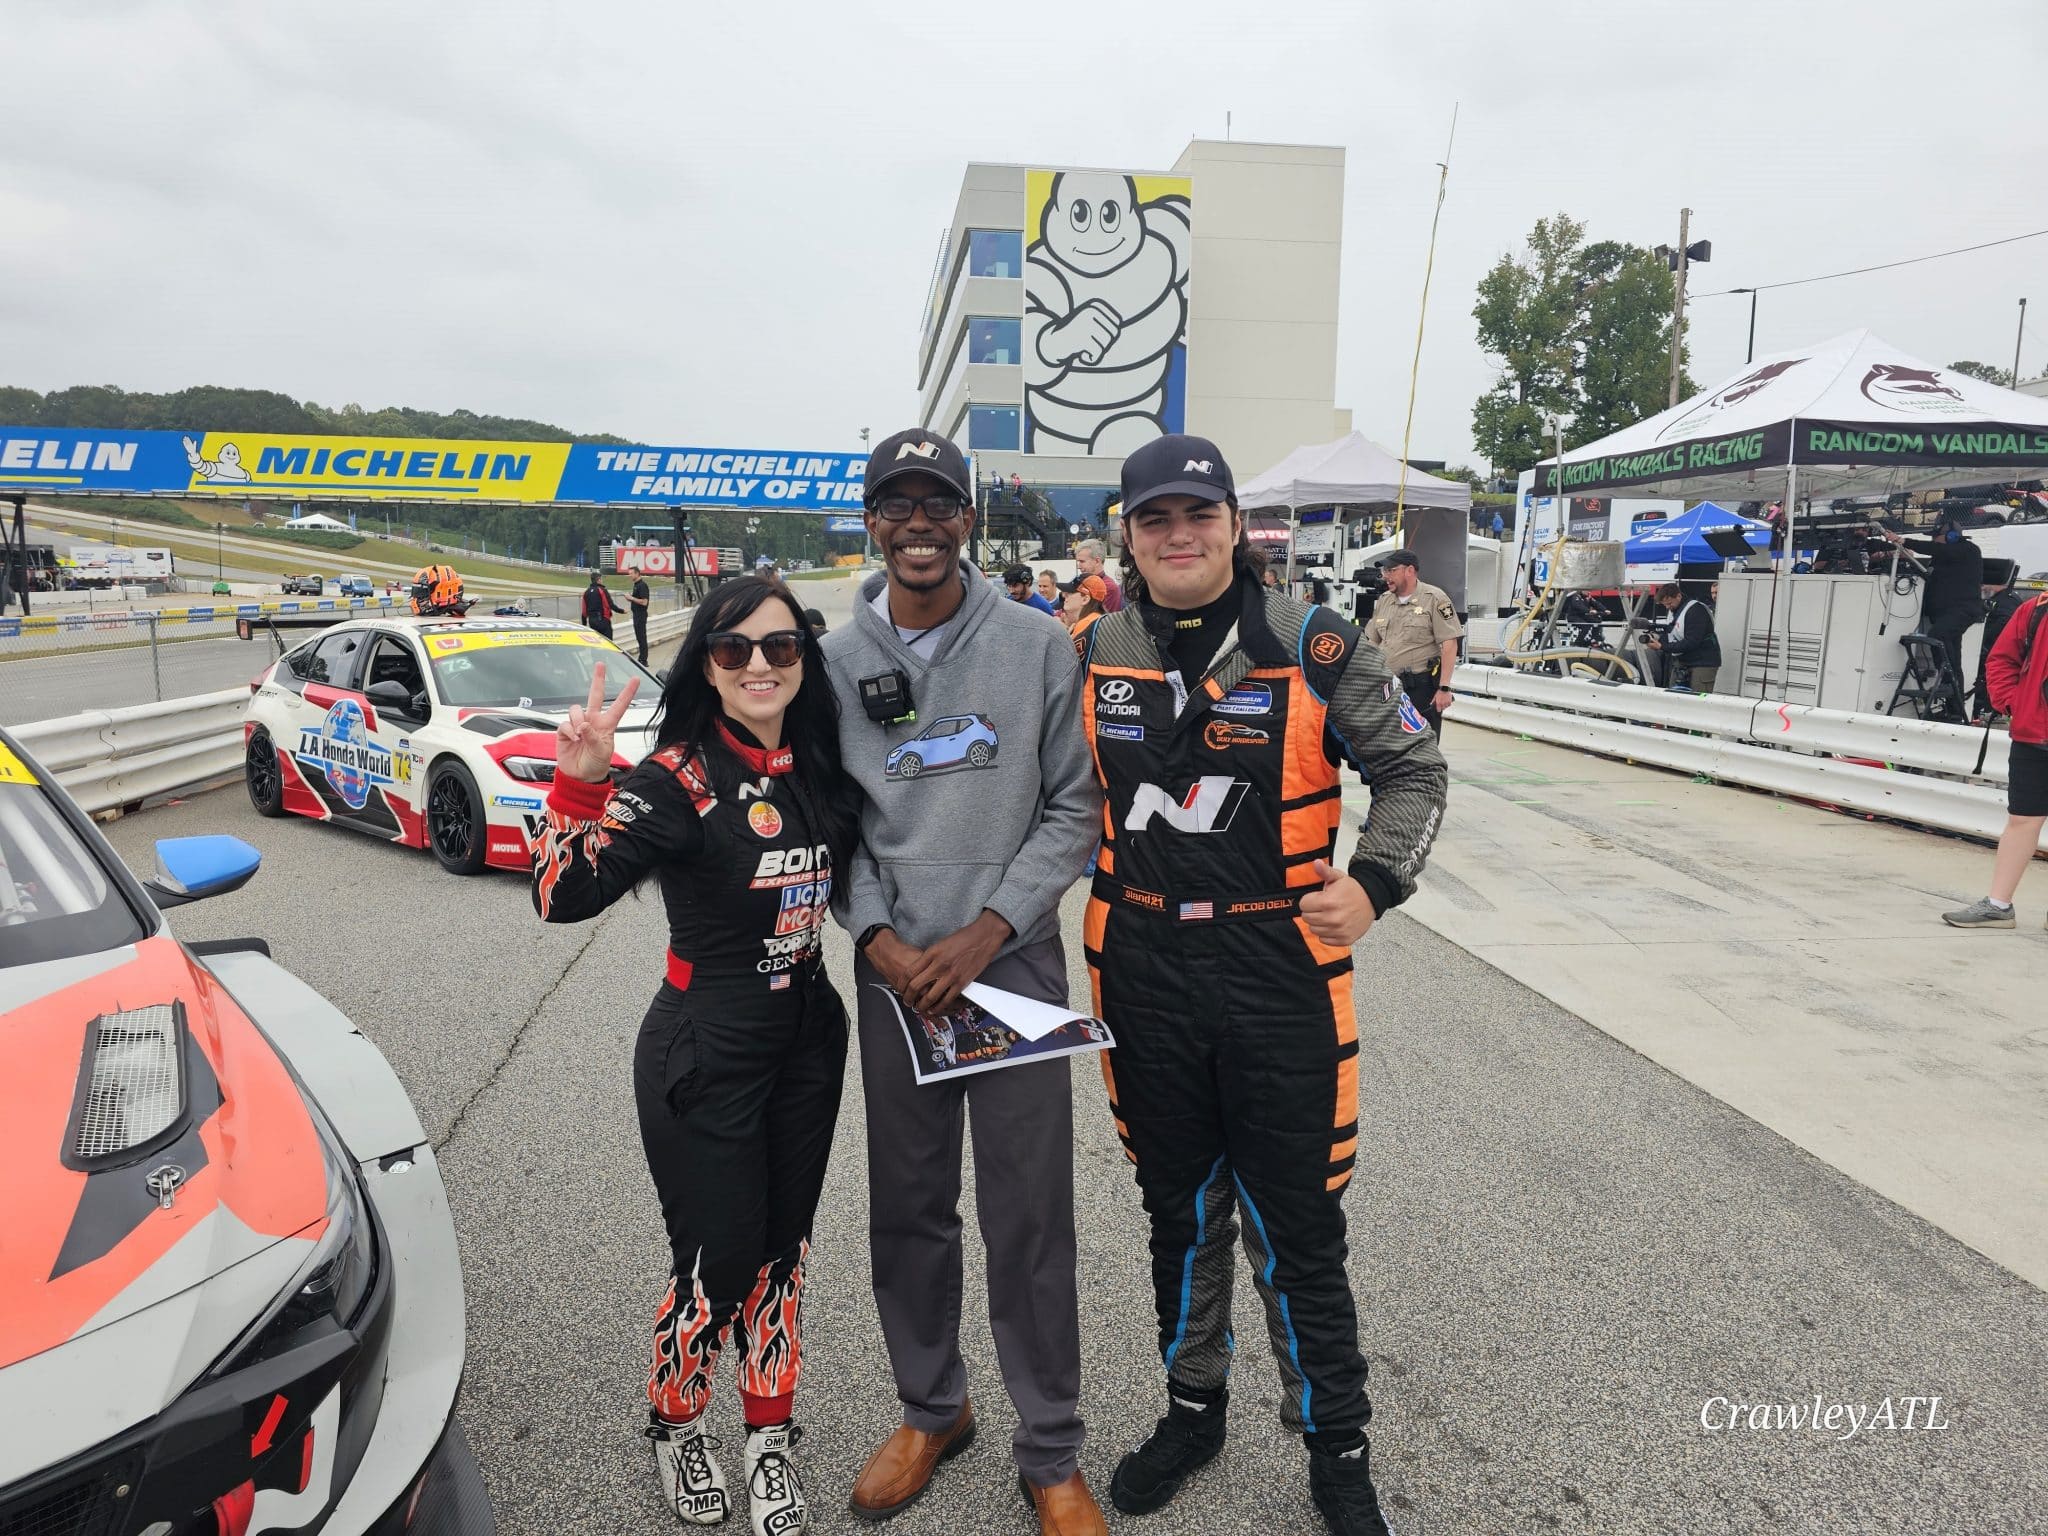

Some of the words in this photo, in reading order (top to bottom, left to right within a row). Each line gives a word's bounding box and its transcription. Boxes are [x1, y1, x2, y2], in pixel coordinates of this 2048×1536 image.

[1809, 430, 1924, 453] RANDOM
[1931, 433, 2048, 454] VANDALS
[0, 439, 138, 471] ELIN
[256, 446, 531, 481] MICHELIN
[597, 451, 662, 472] THE
[1547, 459, 1606, 488] RNDOM
[1610, 447, 1685, 480] VANDALS
[1690, 433, 1764, 468] RACING
[631, 476, 760, 499] FAMILY
[764, 479, 810, 501] OF
[815, 482, 866, 502] TIR
[1318, 639, 1335, 656] 21
[1096, 702, 1141, 716] HYUNDAI
[322, 739, 355, 767] Honda
[357, 748, 391, 777] World
[492, 843, 522, 853] MOTUL
[1226, 903, 1265, 913] JACOB
[675, 1425, 698, 1440] OMP
[764, 1437, 786, 1447] OMP
